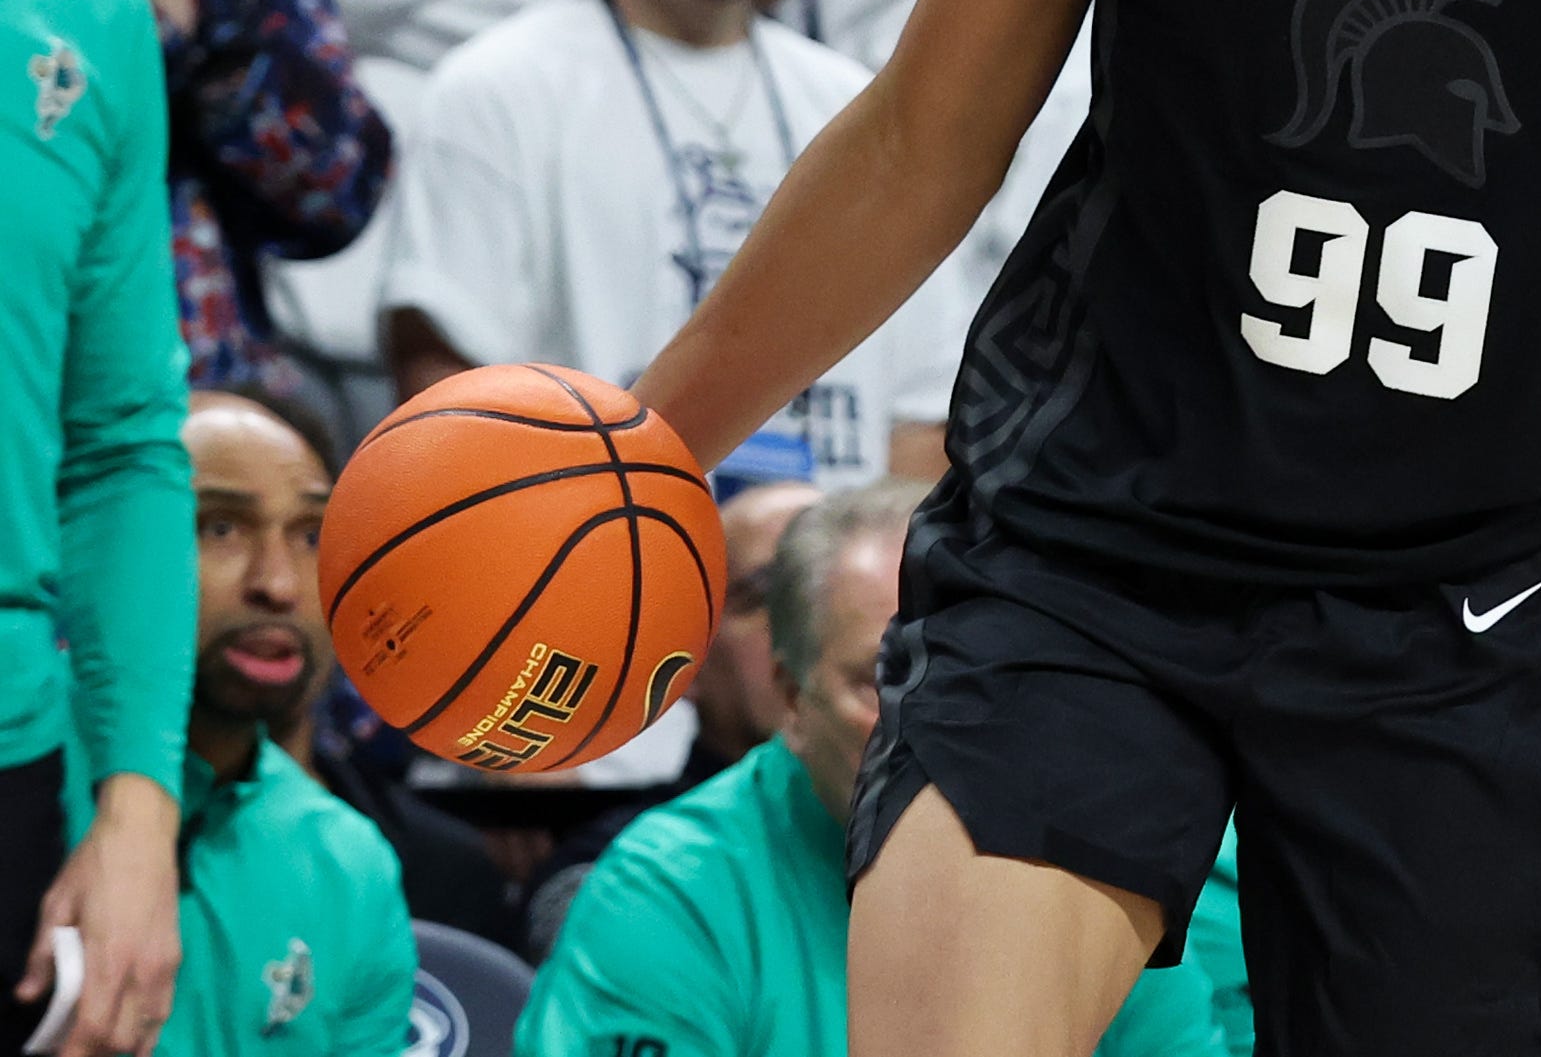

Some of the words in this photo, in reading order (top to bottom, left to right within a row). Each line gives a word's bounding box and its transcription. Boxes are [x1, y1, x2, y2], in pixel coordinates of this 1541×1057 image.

[1240, 189, 1500, 401] 99
[456, 642, 548, 748] CHAMPIONS
[456, 648, 600, 772] ELITE
